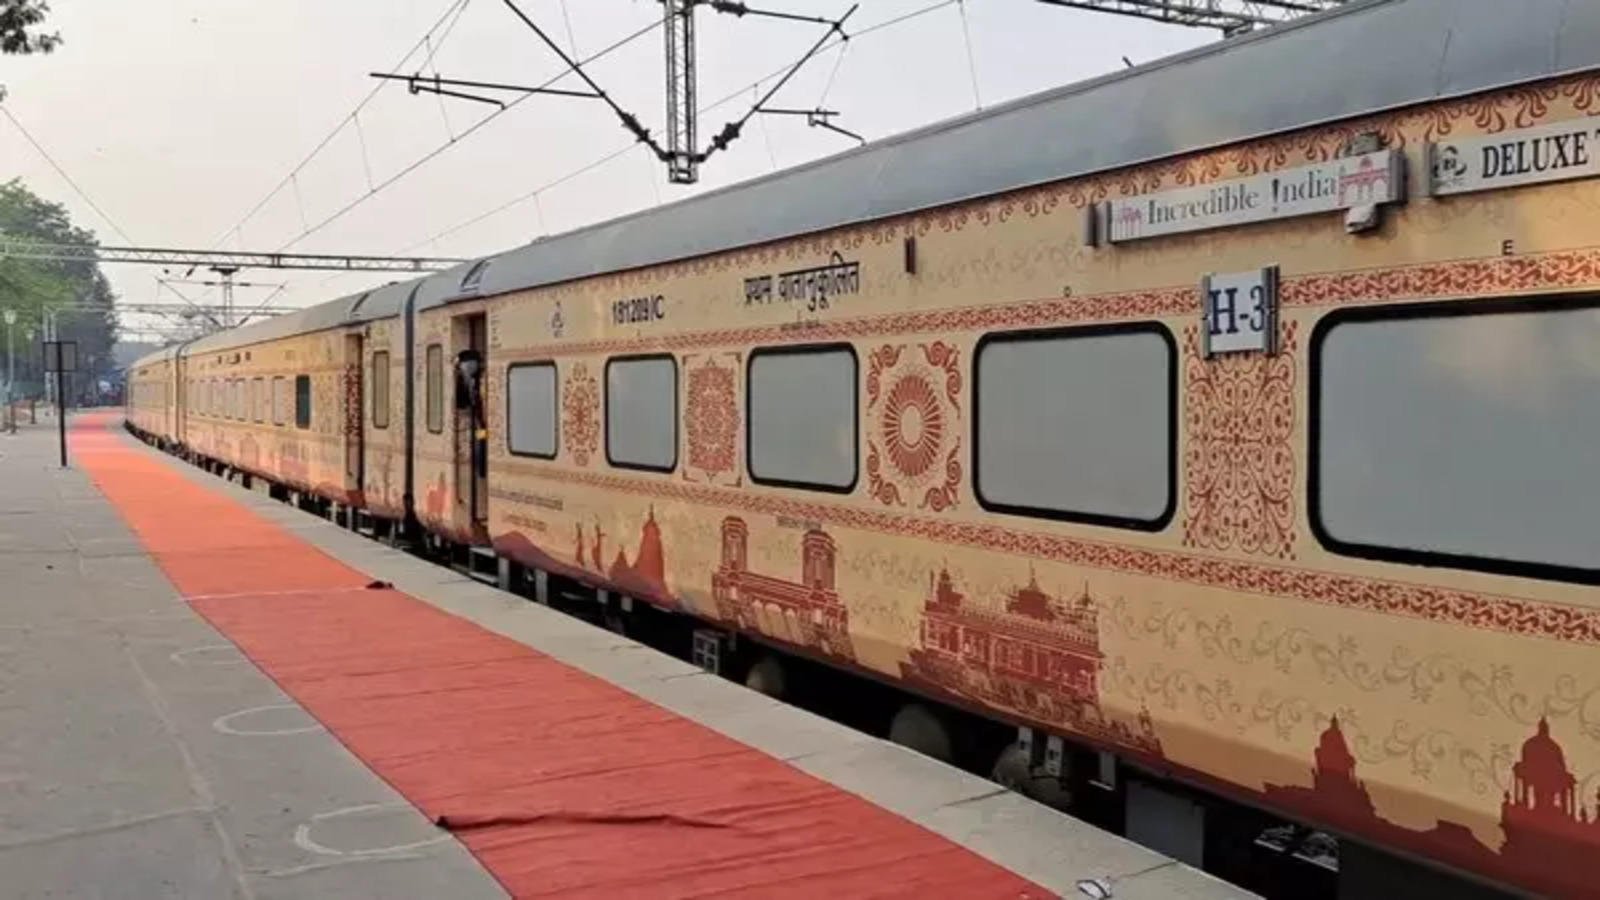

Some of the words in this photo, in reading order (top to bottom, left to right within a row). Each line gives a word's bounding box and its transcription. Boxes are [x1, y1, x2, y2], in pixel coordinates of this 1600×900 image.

[1482, 132, 1588, 178] DELUXE
[1147, 184, 1259, 225] Incredible
[779, 251, 859, 312] वातानुकूलित
[1208, 285, 1264, 335] H-3
